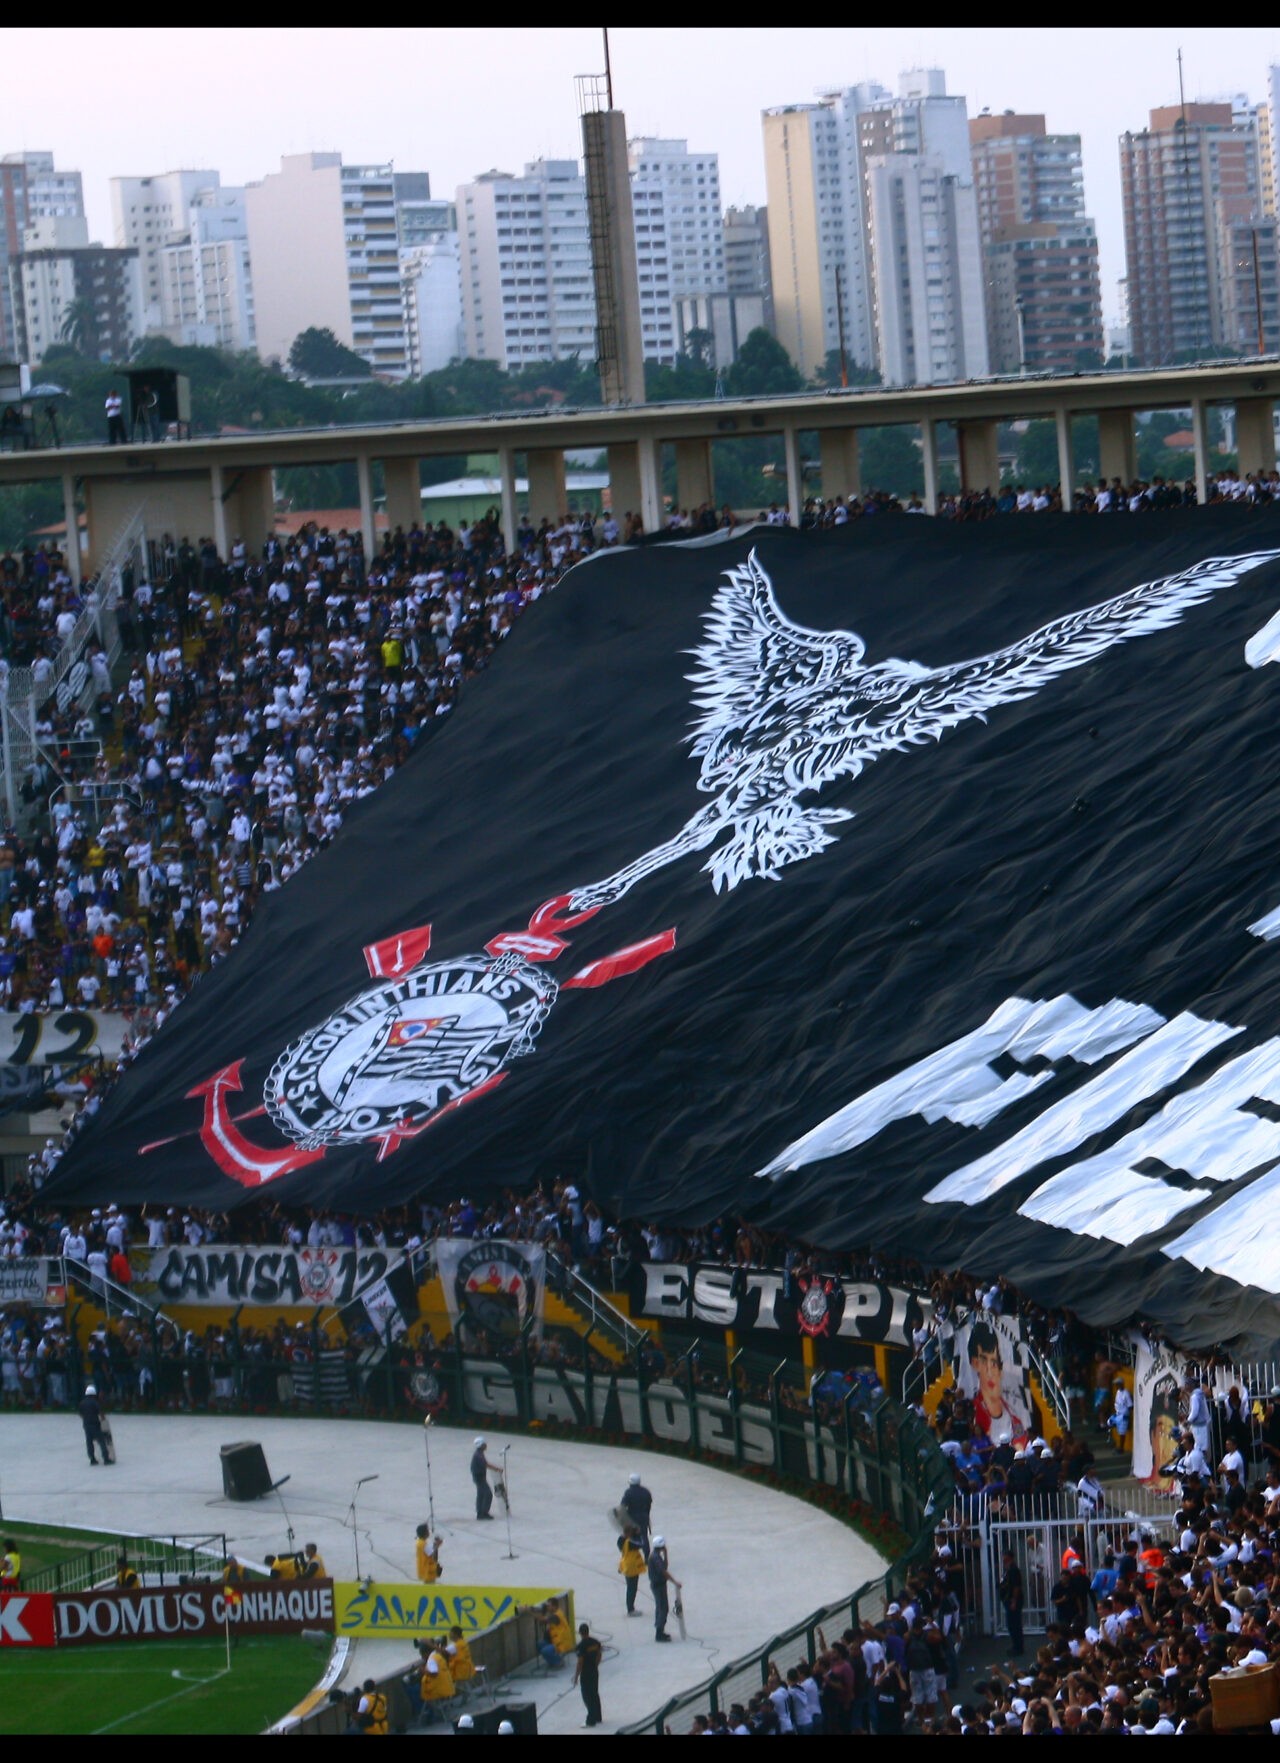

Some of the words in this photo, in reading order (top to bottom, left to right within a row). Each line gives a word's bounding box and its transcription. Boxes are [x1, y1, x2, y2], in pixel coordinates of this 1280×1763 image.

[7, 1012, 99, 1065] 12
[158, 1248, 303, 1304] CAMISA
[334, 1250, 388, 1306] 12
[56, 1592, 206, 1639] DOMUS
[211, 1588, 334, 1625] CONHAQUE
